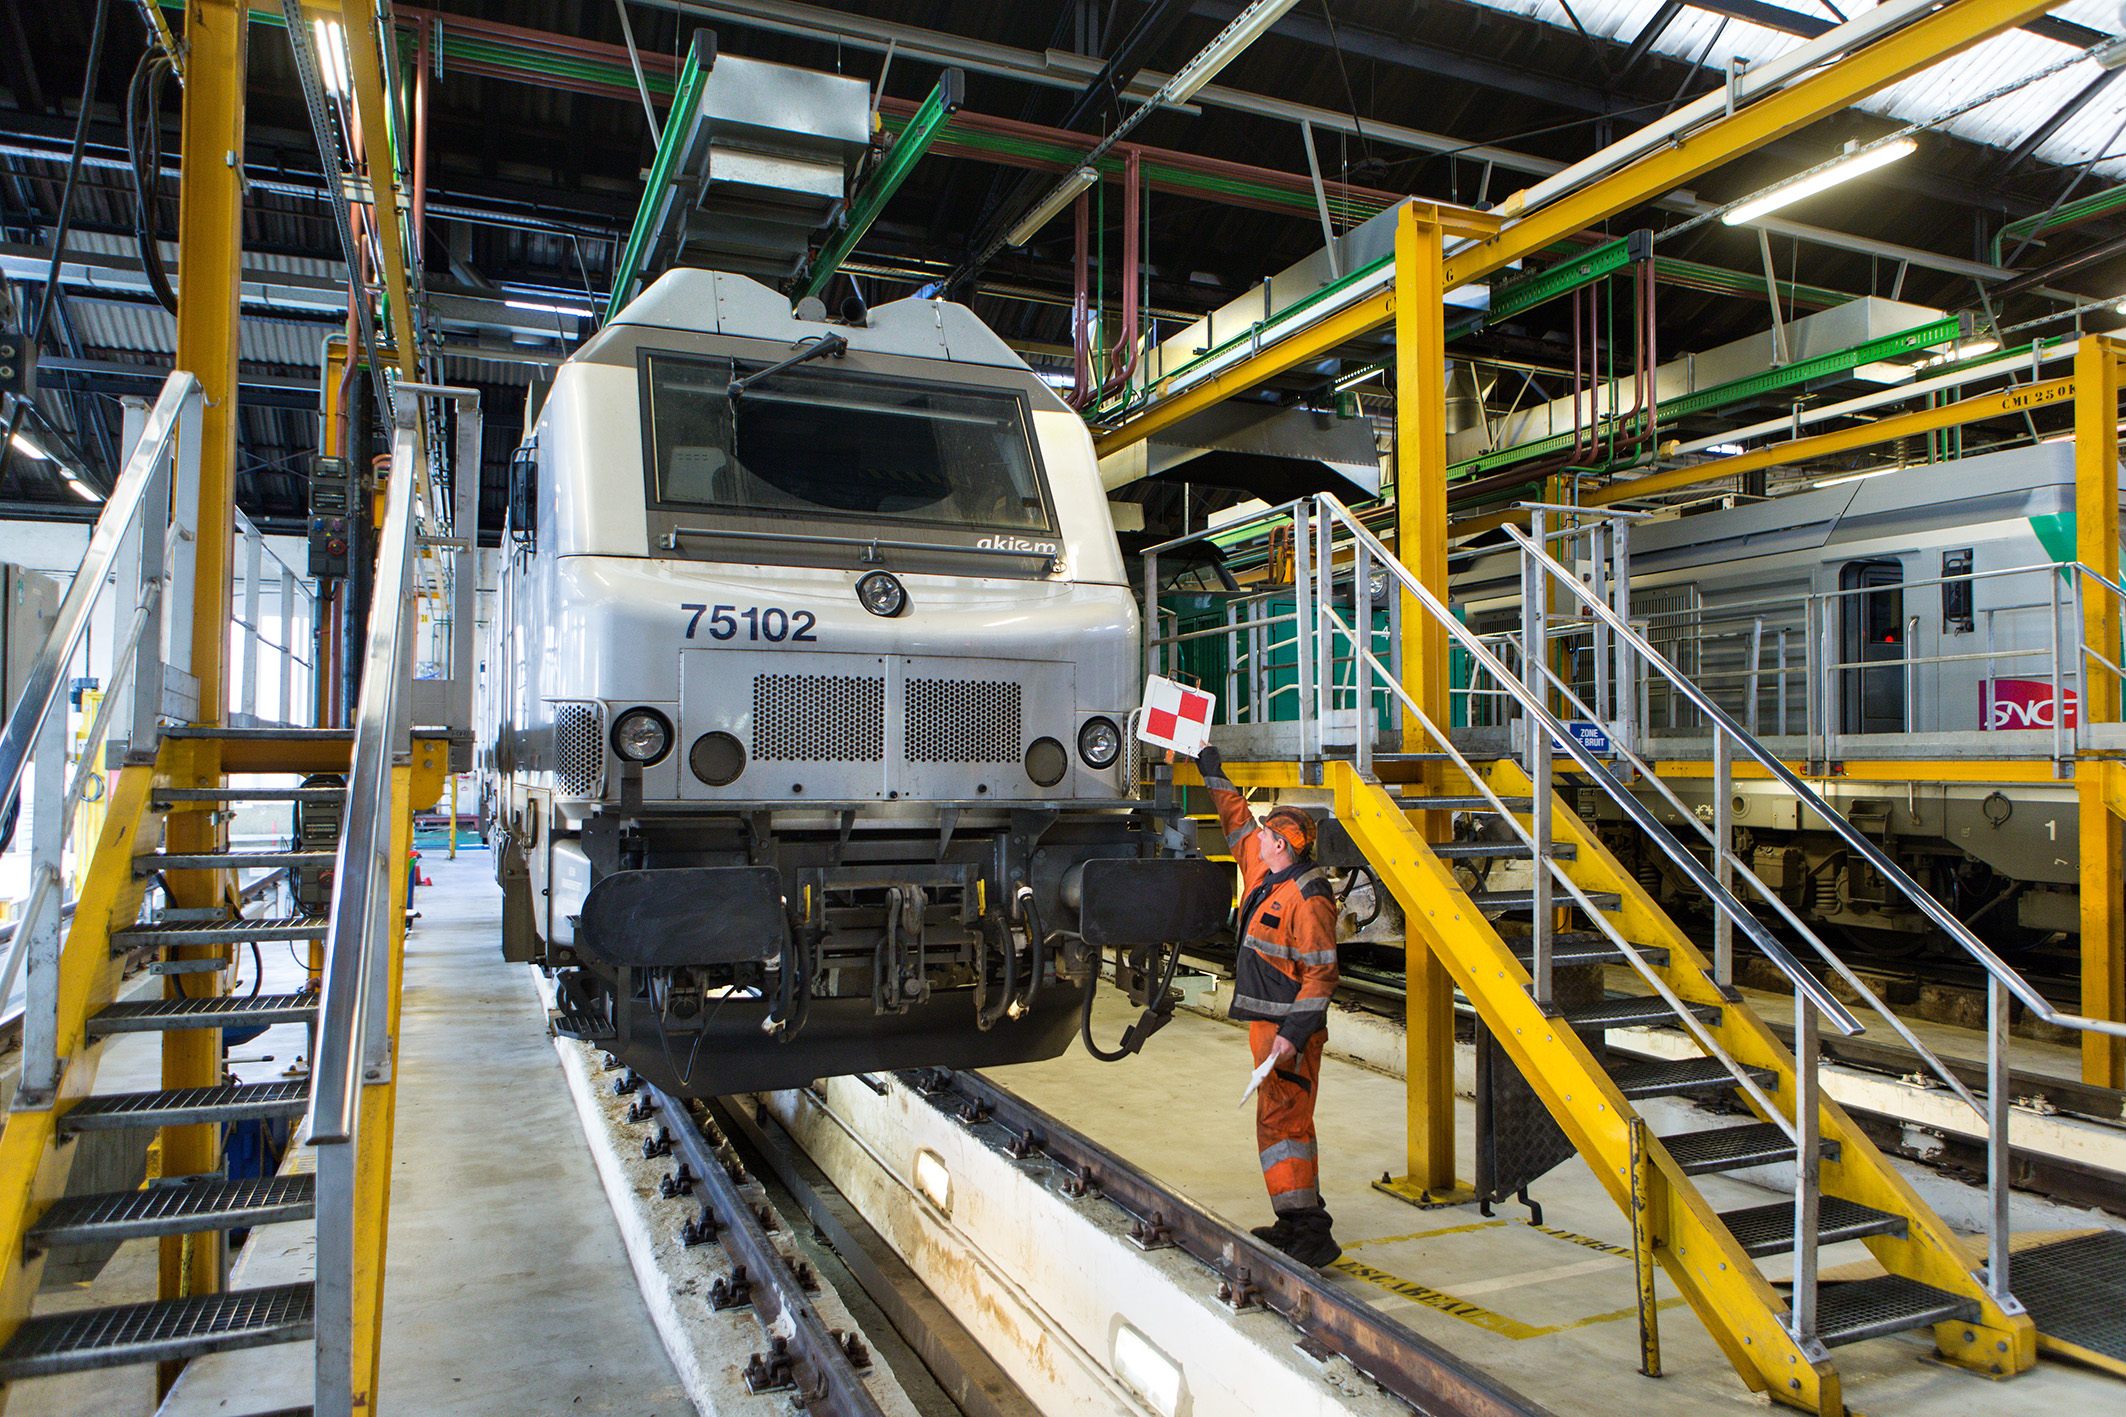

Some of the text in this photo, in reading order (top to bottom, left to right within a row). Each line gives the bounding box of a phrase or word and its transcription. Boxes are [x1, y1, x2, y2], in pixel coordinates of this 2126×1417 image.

[681, 603, 817, 642] 75102
[1580, 729, 1598, 737] ZONE
[1585, 738, 1605, 747] BRUIT
[2044, 820, 2056, 841] 1
[1334, 1261, 1491, 1318] ESCABEAU
